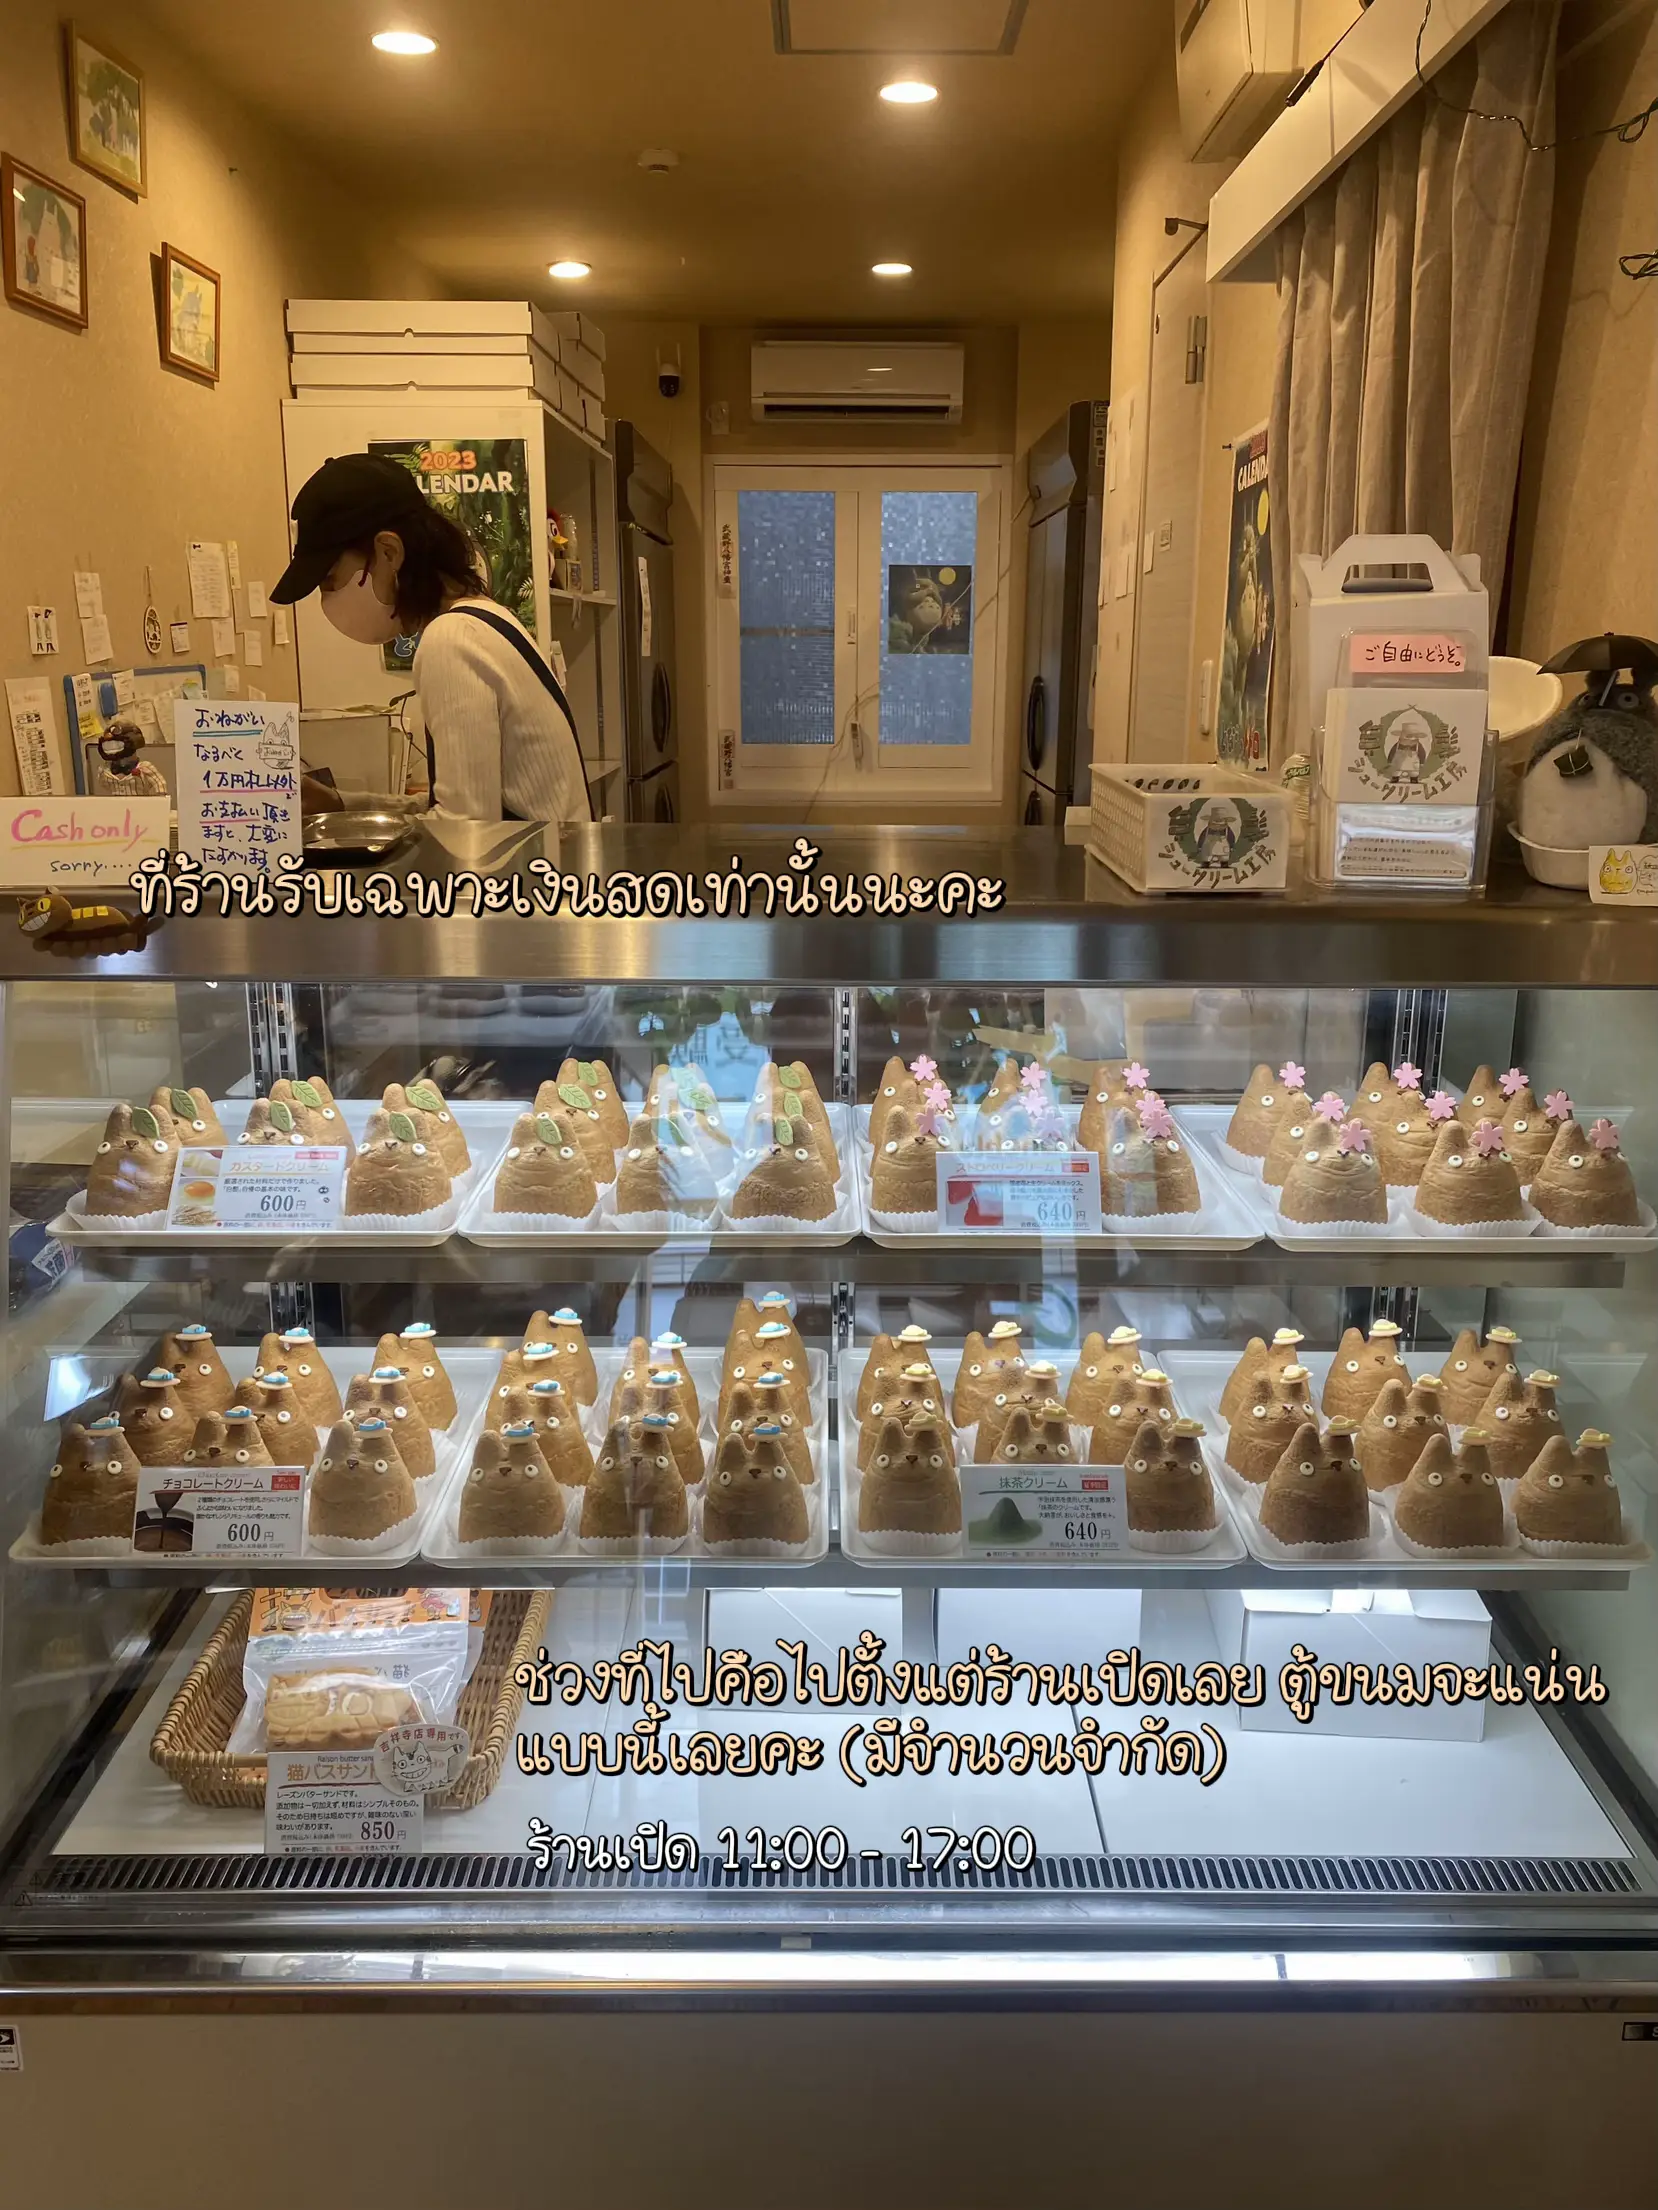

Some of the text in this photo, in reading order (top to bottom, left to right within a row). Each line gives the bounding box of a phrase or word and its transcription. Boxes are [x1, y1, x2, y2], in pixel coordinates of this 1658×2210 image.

[420, 451, 477, 471] 2023
[417, 471, 514, 494] LENDAR
[1238, 454, 1268, 492] CALEND
[1364, 640, 1464, 667] ご自由にどうぞ。
[194, 708, 265, 728] おねがい
[193, 743, 244, 762] なるべく
[11, 808, 149, 853] Cash only
[162, 1478, 264, 1490] チョコレートクリーム
[999, 1476, 1068, 1489] 抹茶クリーム
